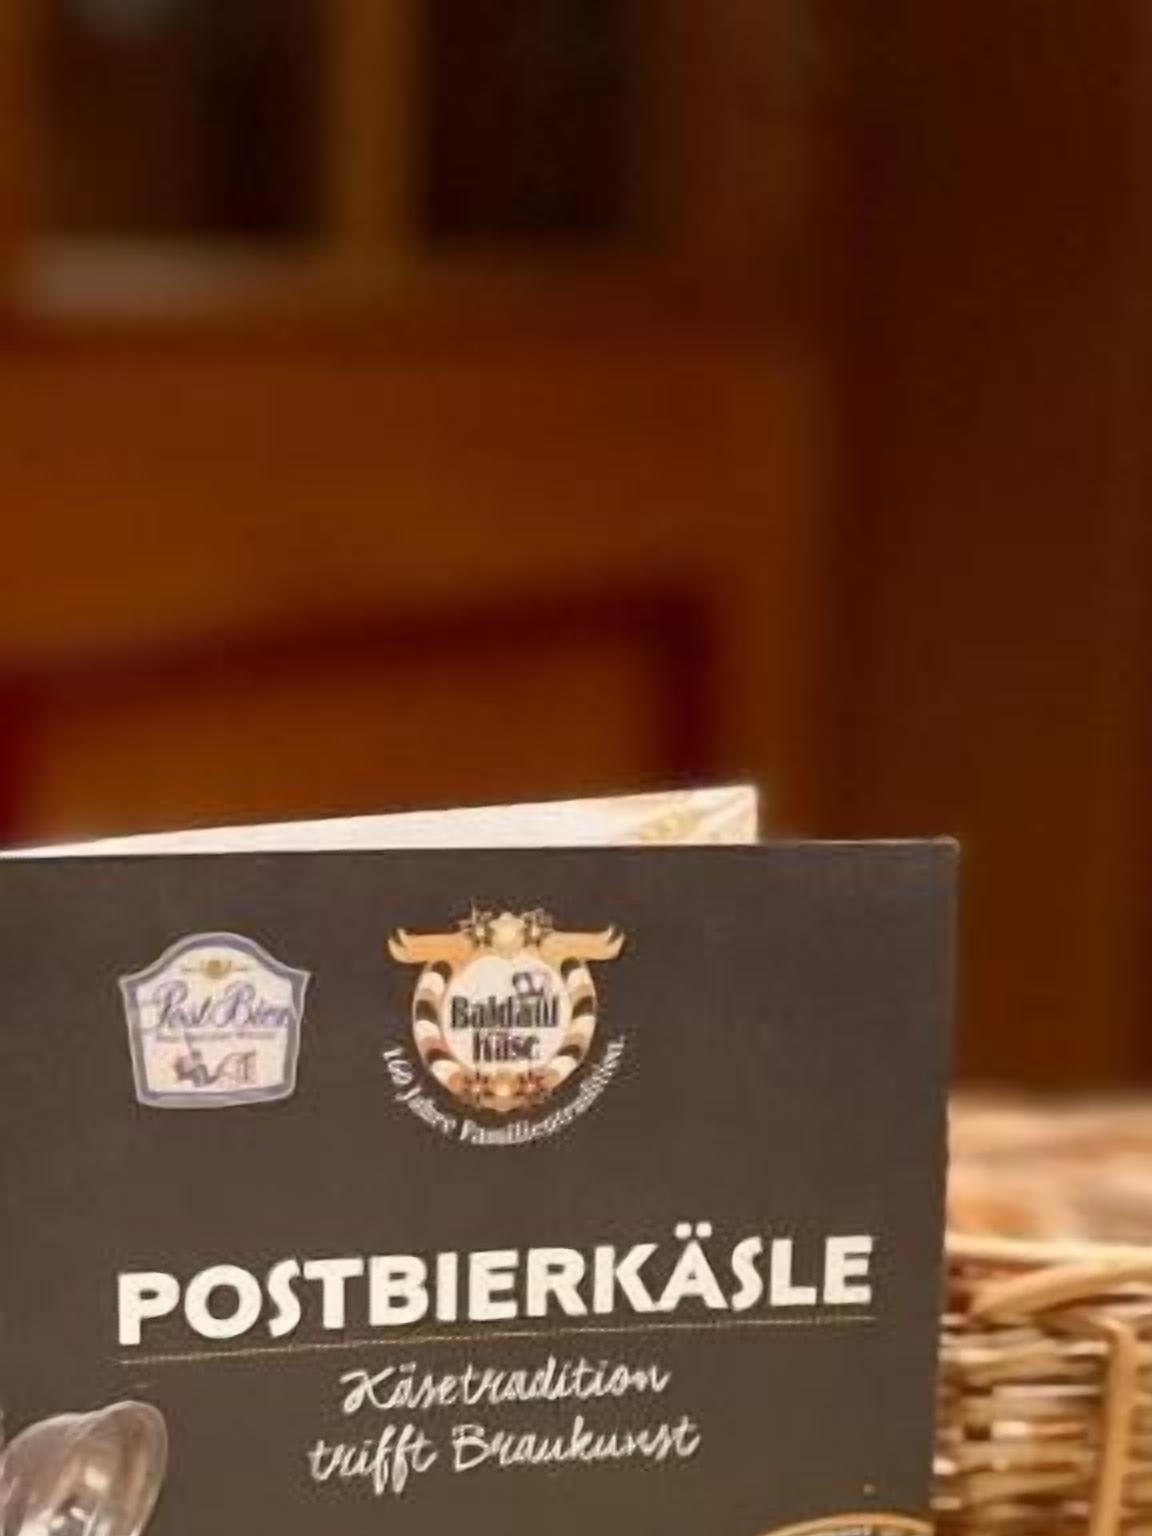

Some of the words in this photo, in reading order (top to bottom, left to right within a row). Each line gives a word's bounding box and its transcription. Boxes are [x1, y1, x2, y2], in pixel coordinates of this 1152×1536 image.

[117, 1222, 875, 1346] POSTBIERKÄSLE
[338, 1354, 672, 1415] Käsetradition
[306, 1423, 439, 1496] trifft
[451, 1415, 701, 1473] Braukunst
